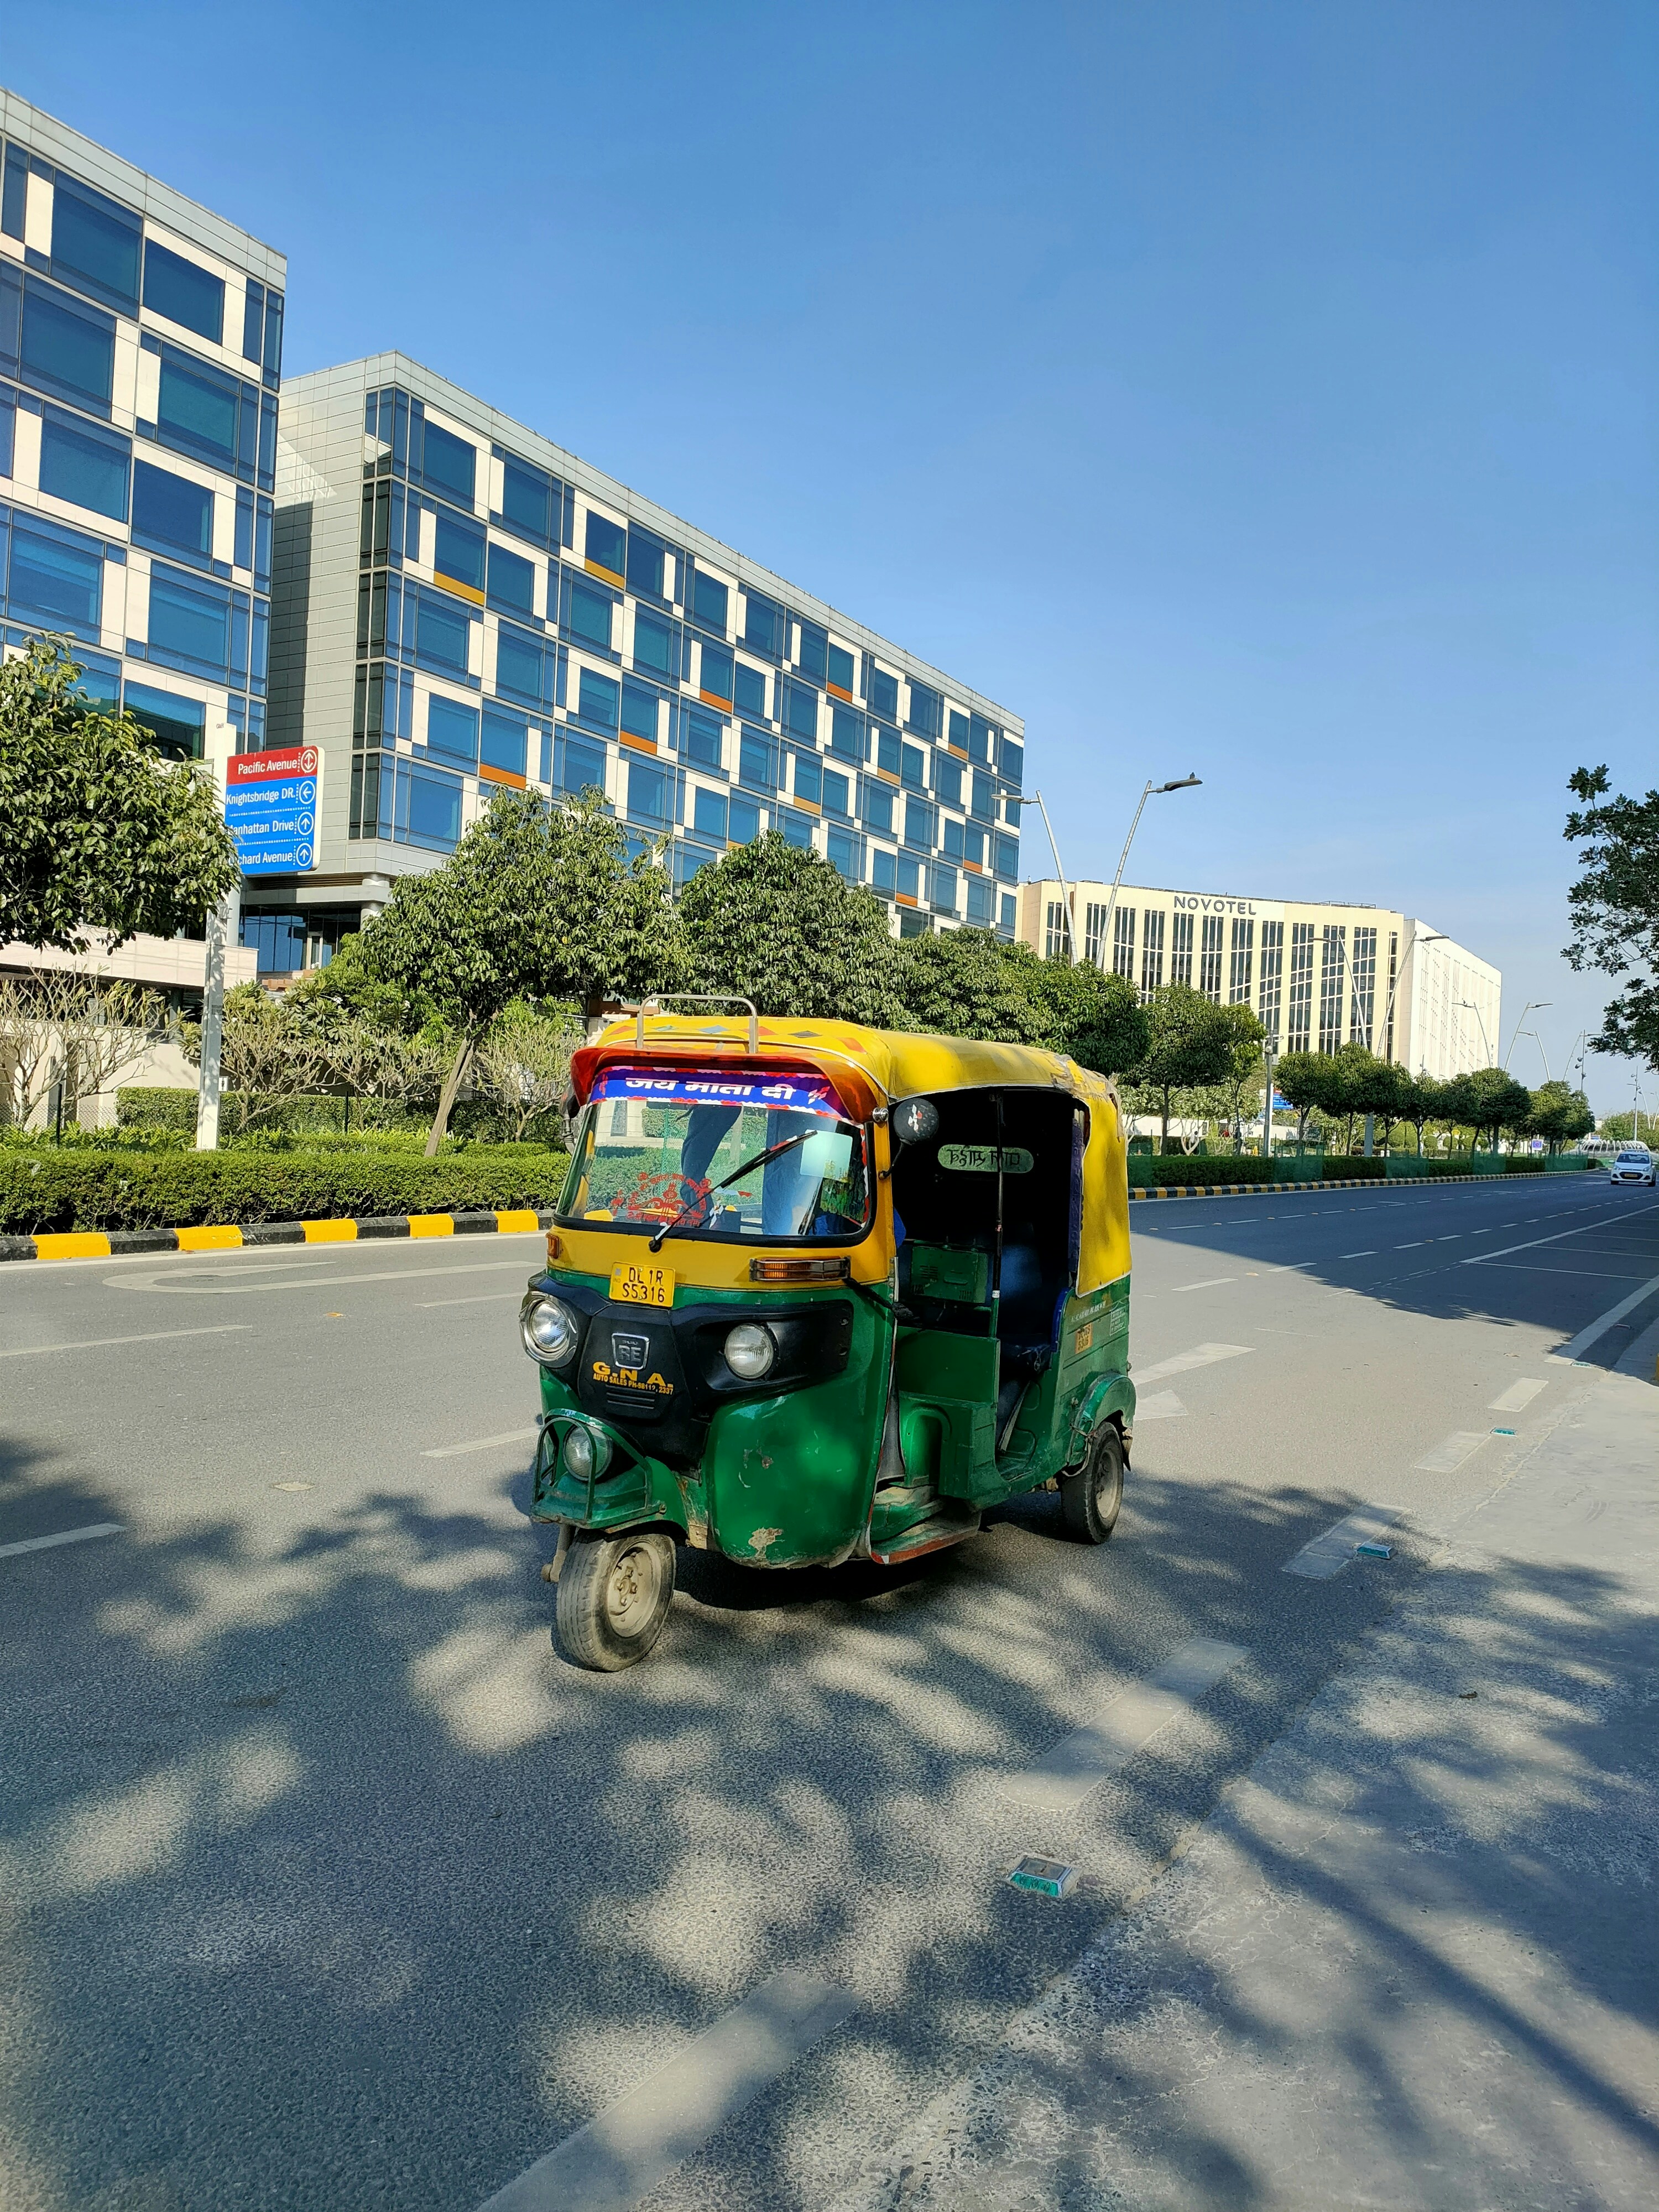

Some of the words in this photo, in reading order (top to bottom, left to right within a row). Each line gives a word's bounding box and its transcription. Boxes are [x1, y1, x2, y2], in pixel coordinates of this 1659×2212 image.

[238, 761, 265, 775] Pacific
[267, 758, 298, 772] Avenue
[226, 790, 279, 806] Knightsbridge
[281, 787, 295, 800] DR.
[273, 820, 294, 832] Drive
[228, 852, 261, 867] chard
[262, 852, 293, 864] Avenue
[1174, 895, 1257, 915] NOVOTEL
[625, 1077, 680, 1091] जय
[685, 1081, 755, 1096] माता
[761, 1083, 797, 1100] दी
[629, 1267, 644, 1284] DL
[650, 1270, 664, 1286] 1R
[622, 1282, 665, 1302] S5316
[618, 1345, 641, 1361] RE
[593, 1373, 608, 1383] AUTO
[609, 1376, 628, 1386] SALES
